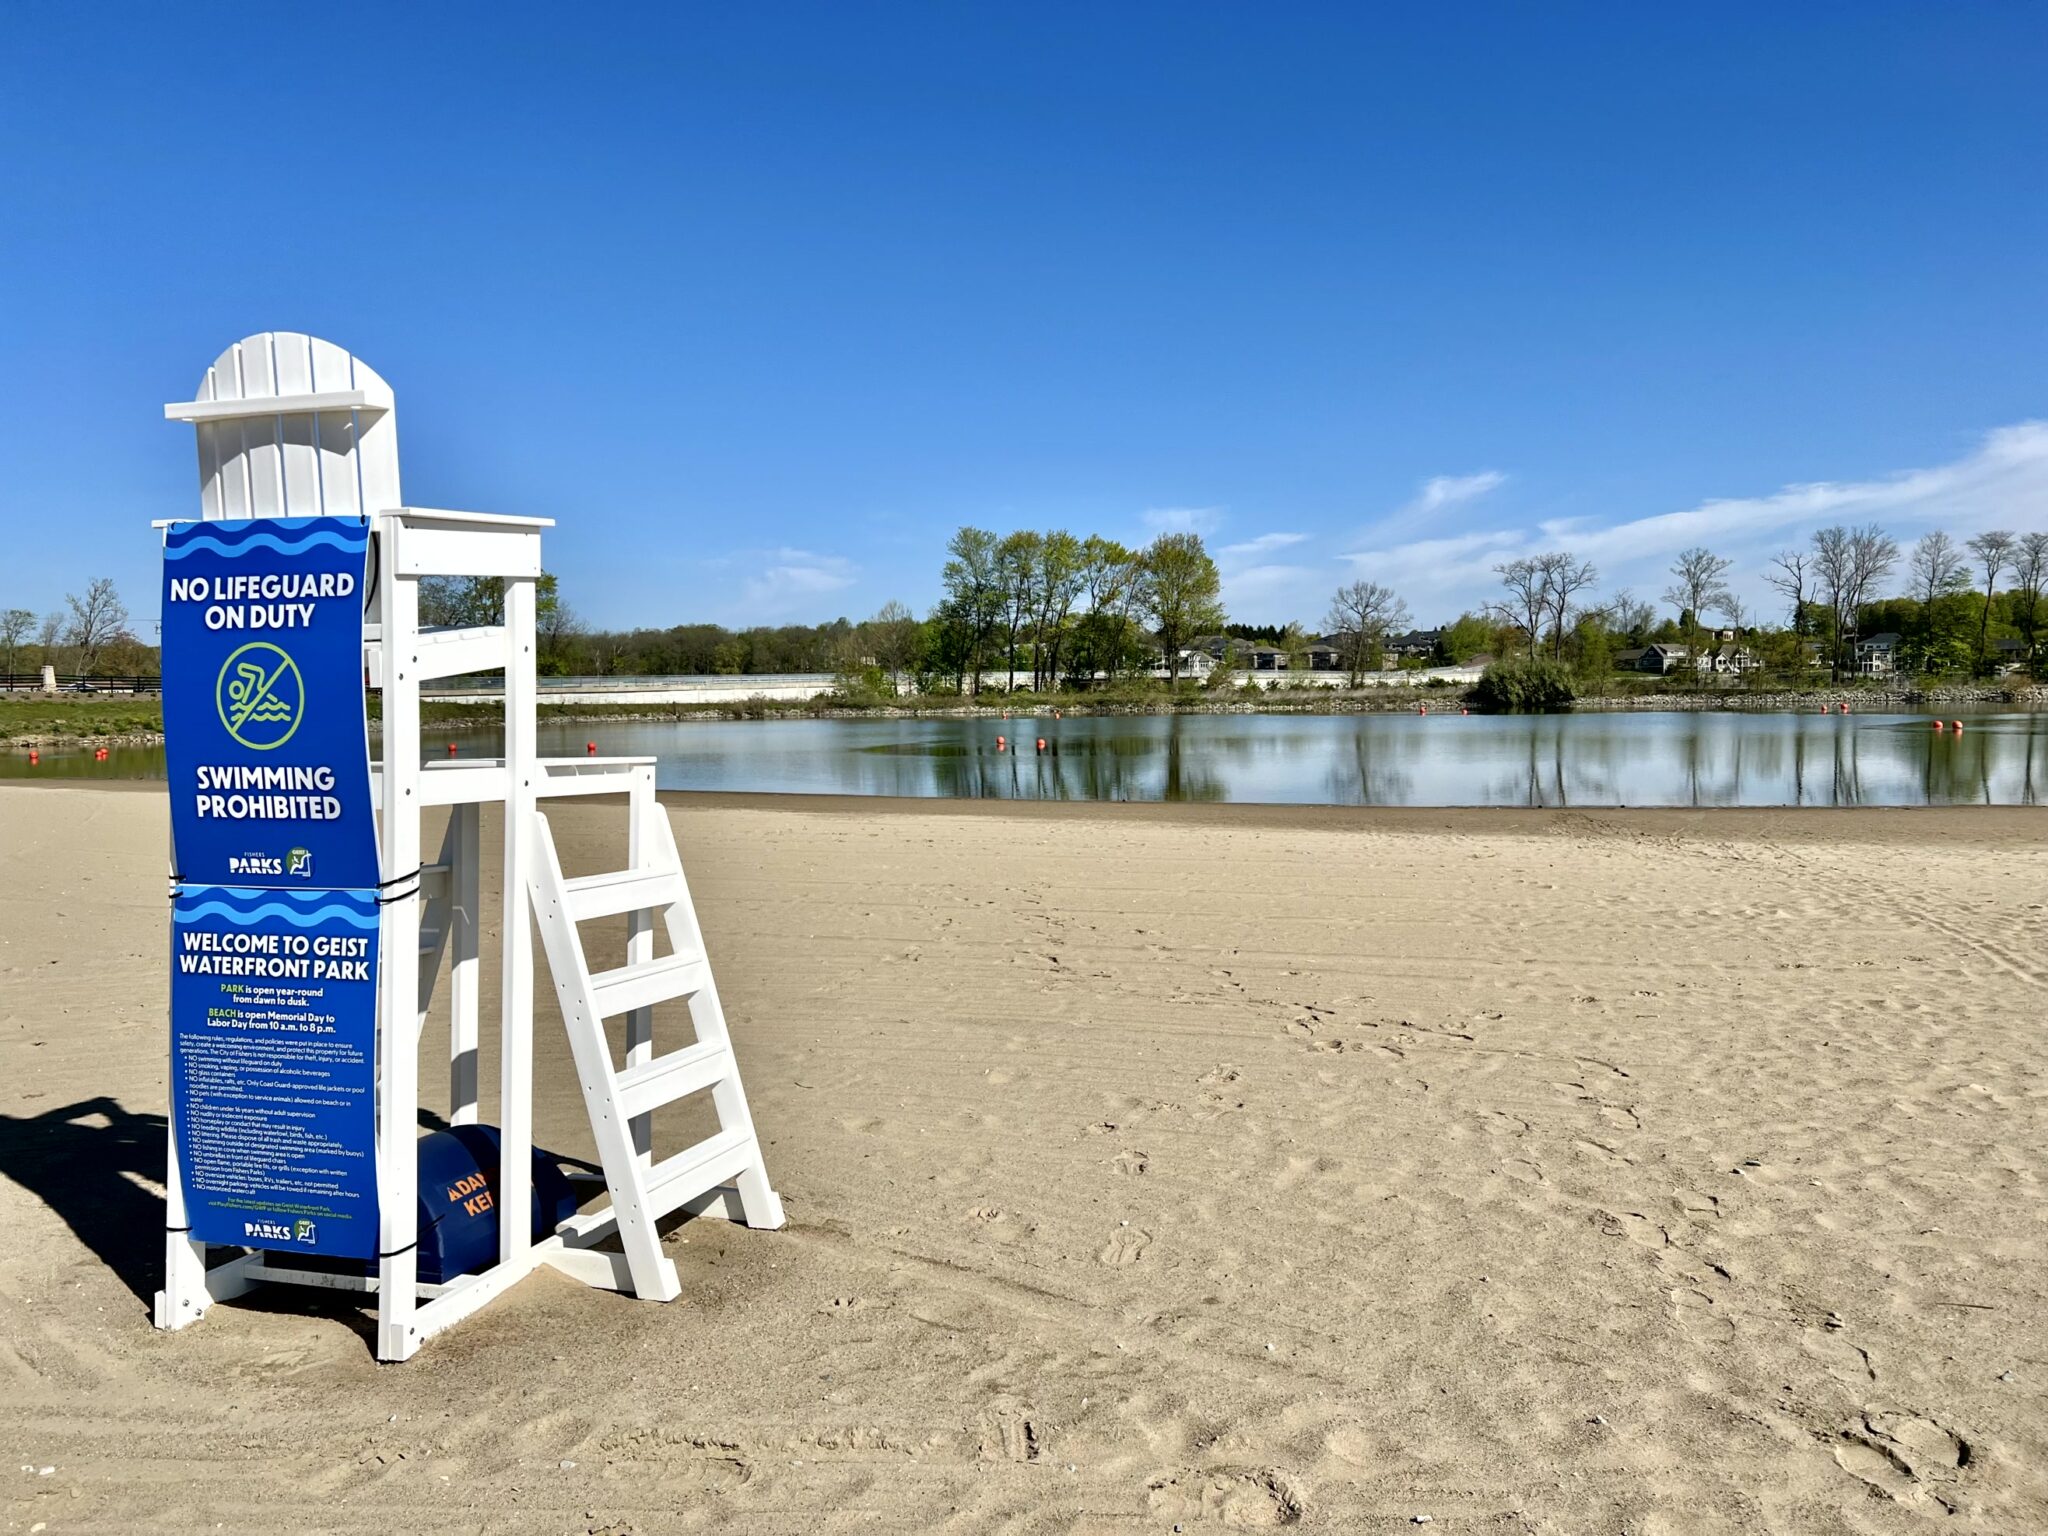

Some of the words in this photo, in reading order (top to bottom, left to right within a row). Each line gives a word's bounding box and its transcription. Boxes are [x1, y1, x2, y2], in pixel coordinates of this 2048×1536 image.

[170, 578, 210, 602] NO
[214, 573, 354, 600] LIFEGUARD
[205, 605, 244, 630] ON
[250, 603, 315, 629] DUTY
[197, 766, 335, 791] SWIMMING
[196, 794, 341, 820] PROHIBITED
[229, 858, 282, 874] PARKS
[183, 932, 278, 954] WELCOME
[282, 936, 309, 955] TO
[314, 937, 368, 956] GEIST
[180, 954, 310, 978] WATERFRONT
[314, 959, 370, 980] PARK
[220, 984, 244, 993] PARK
[245, 984, 252, 994] is
[253, 987, 274, 998] open
[276, 987, 323, 1000] year-round
[233, 994, 252, 1003] from
[254, 995, 276, 1005] dawn
[277, 996, 286, 1005] to
[288, 997, 310, 1006] dusk.
[207, 1018, 230, 1028] Labor
[232, 1020, 247, 1030] Day
[249, 1020, 268, 1030] from
[270, 1021, 279, 1030] 10
[310, 1023, 316, 1032] 8
[317, 1026, 336, 1034] p.m.
[208, 1008, 236, 1018] BEACH
[238, 1009, 243, 1018] is
[244, 1012, 266, 1023] open
[267, 1012, 307, 1022] Memorial
[308, 1012, 324, 1025] Day
[326, 1014, 335, 1023] to
[244, 1222, 291, 1240] PARKS
